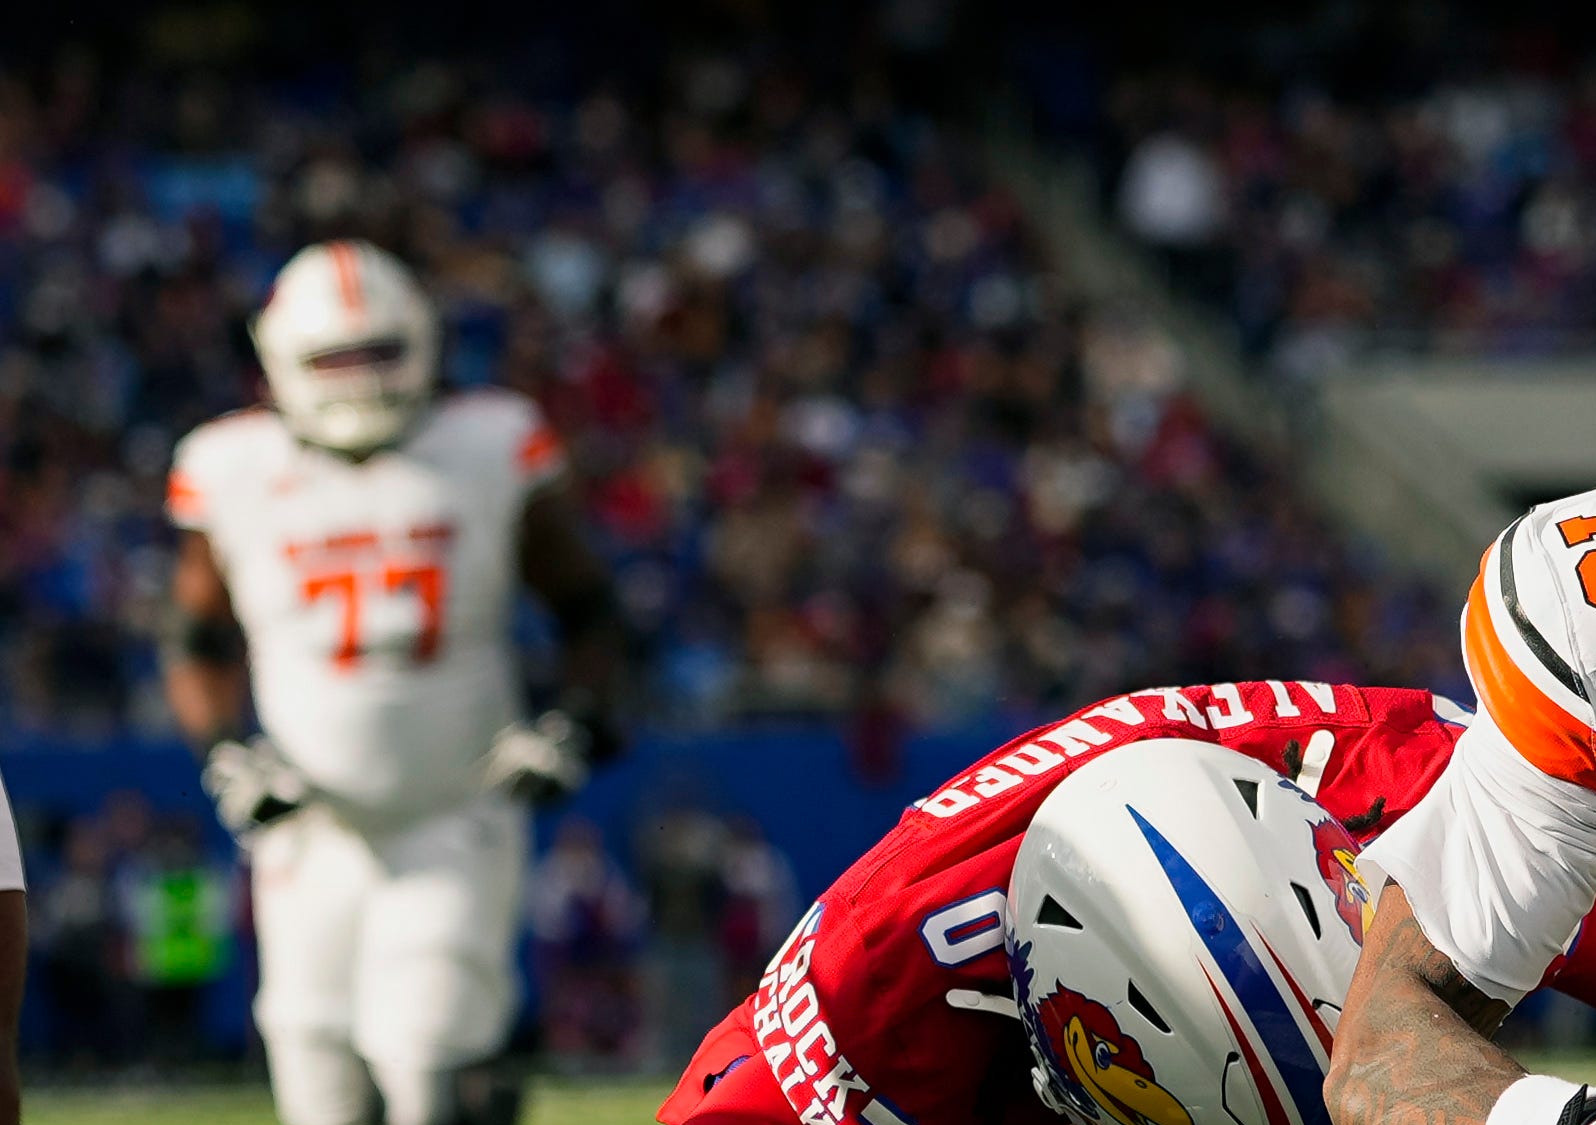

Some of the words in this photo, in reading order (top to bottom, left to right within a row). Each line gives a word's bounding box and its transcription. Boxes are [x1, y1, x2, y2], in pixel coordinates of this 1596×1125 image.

[299, 563, 447, 676] 77
[919, 886, 1006, 969] 0
[778, 939, 870, 1121] ROCK
